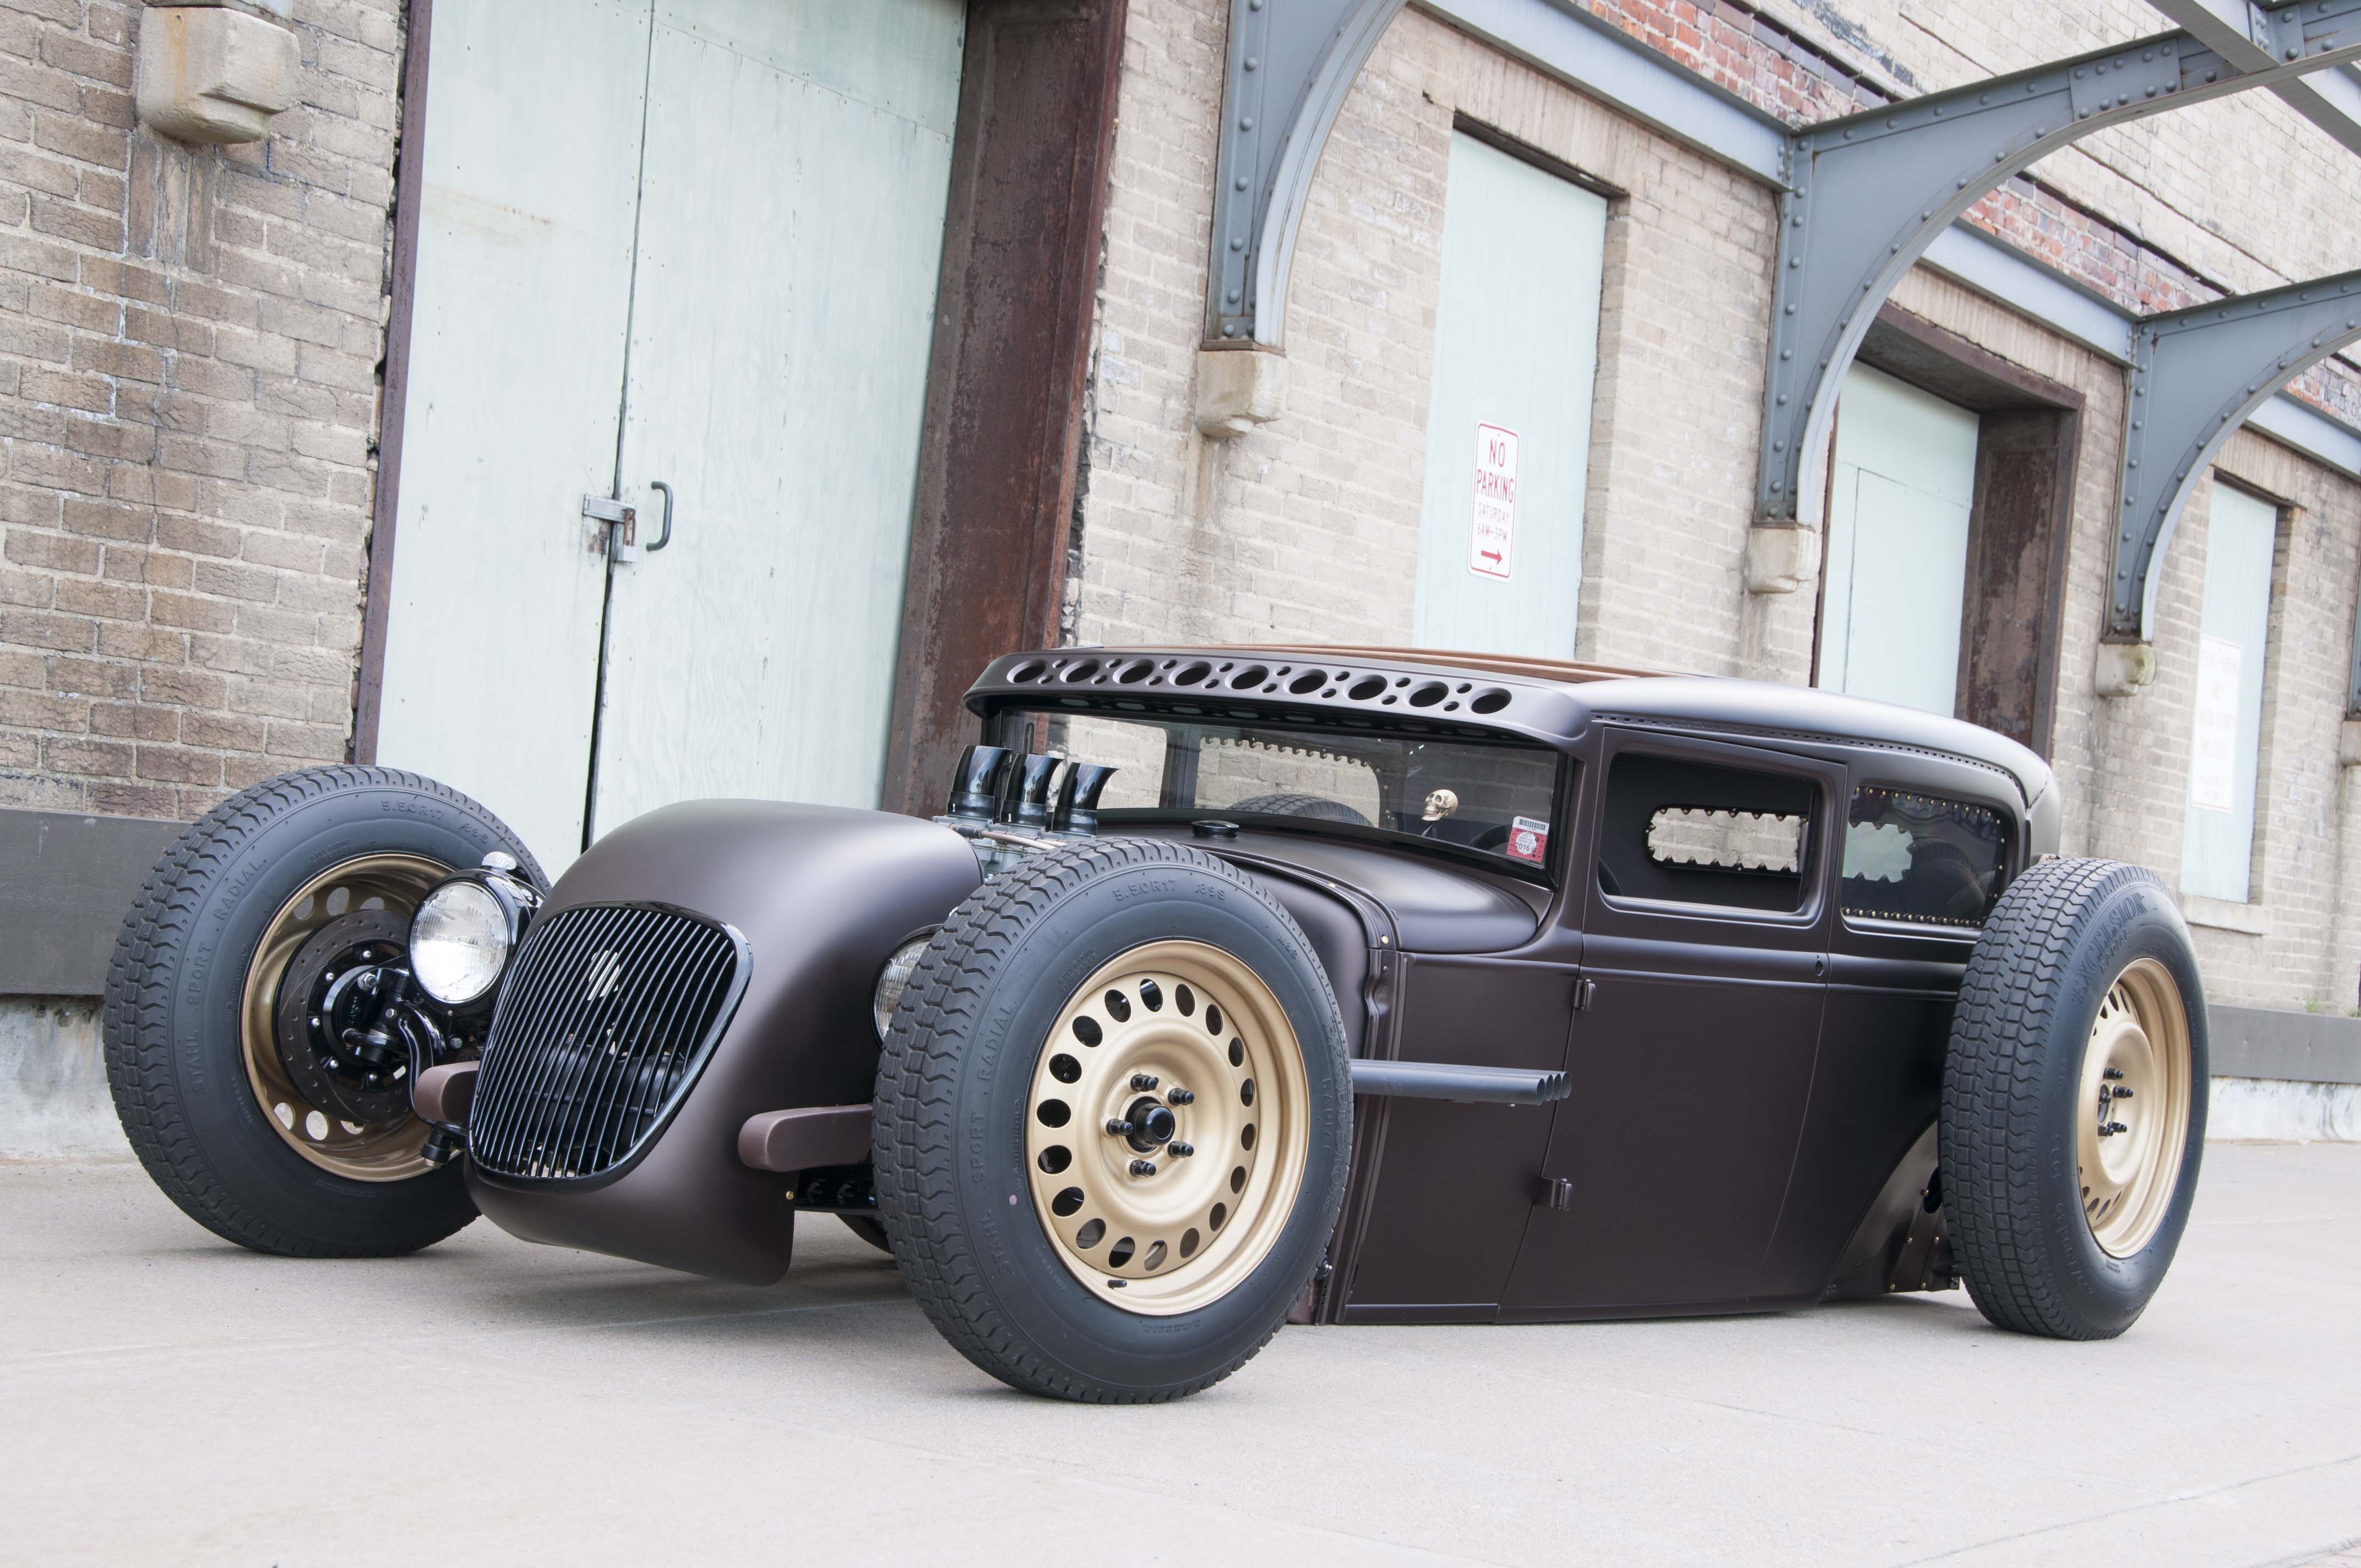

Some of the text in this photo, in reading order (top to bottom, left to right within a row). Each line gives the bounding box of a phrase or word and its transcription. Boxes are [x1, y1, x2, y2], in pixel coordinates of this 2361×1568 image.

[1489, 439, 1505, 467] NO
[1477, 469, 1514, 503] PARKING
[1478, 503, 1510, 524] SATURDAY
[381, 799, 444, 820] 5.50R17
[1515, 842, 1531, 851] 2016
[1113, 880, 1177, 901] 5.50R17
[187, 942, 213, 1005] SPORT
[213, 859, 263, 920] RADIAL
[2070, 892, 2147, 1007] EXCELSIOR
[1322, 1020, 1348, 1212] EXCELSIOR
[970, 1003, 1014, 1275] STAHL SPORT RADIAL
